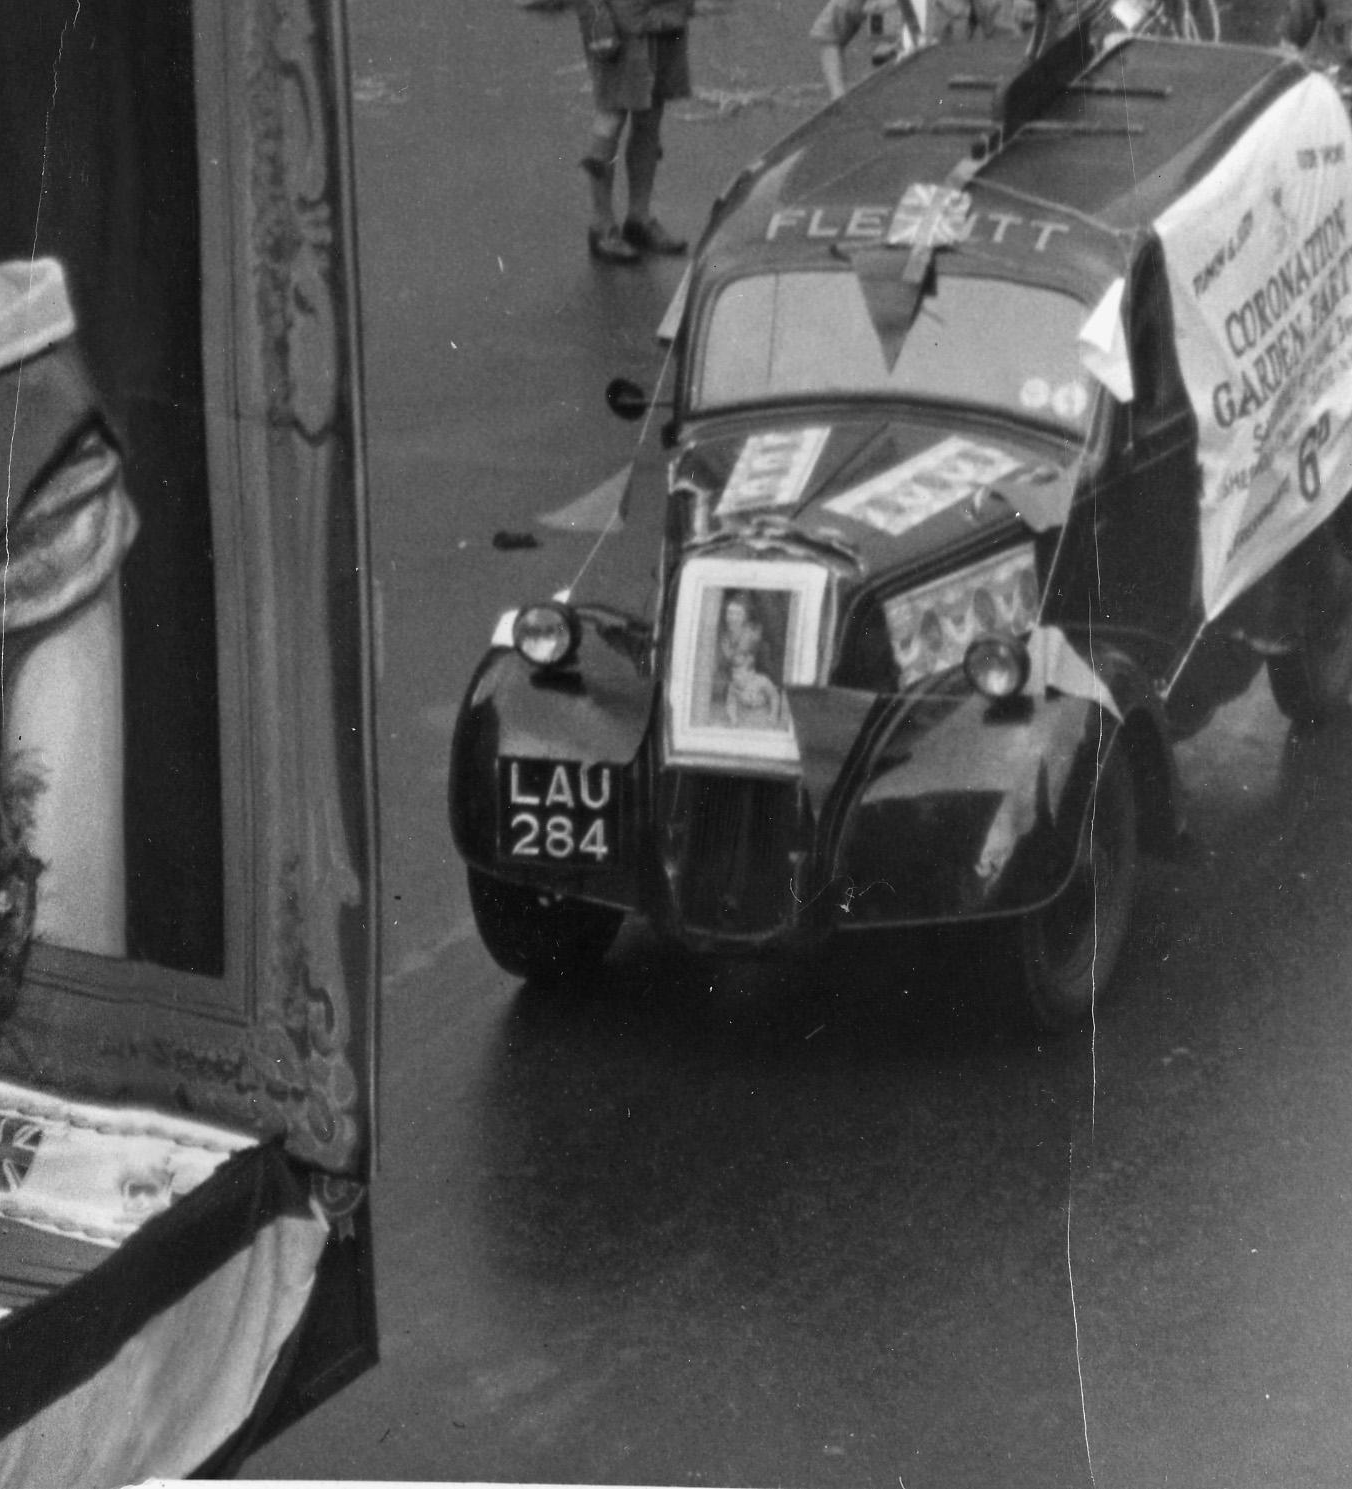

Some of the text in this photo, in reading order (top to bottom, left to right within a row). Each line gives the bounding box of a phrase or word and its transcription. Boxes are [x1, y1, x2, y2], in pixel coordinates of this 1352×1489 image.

[764, 206, 1070, 253] FLEITT
[1224, 198, 1347, 359] CORONATION
[1212, 311, 1307, 428] GARDEN
[510, 761, 610, 810] LAU
[510, 812, 609, 862] 284
